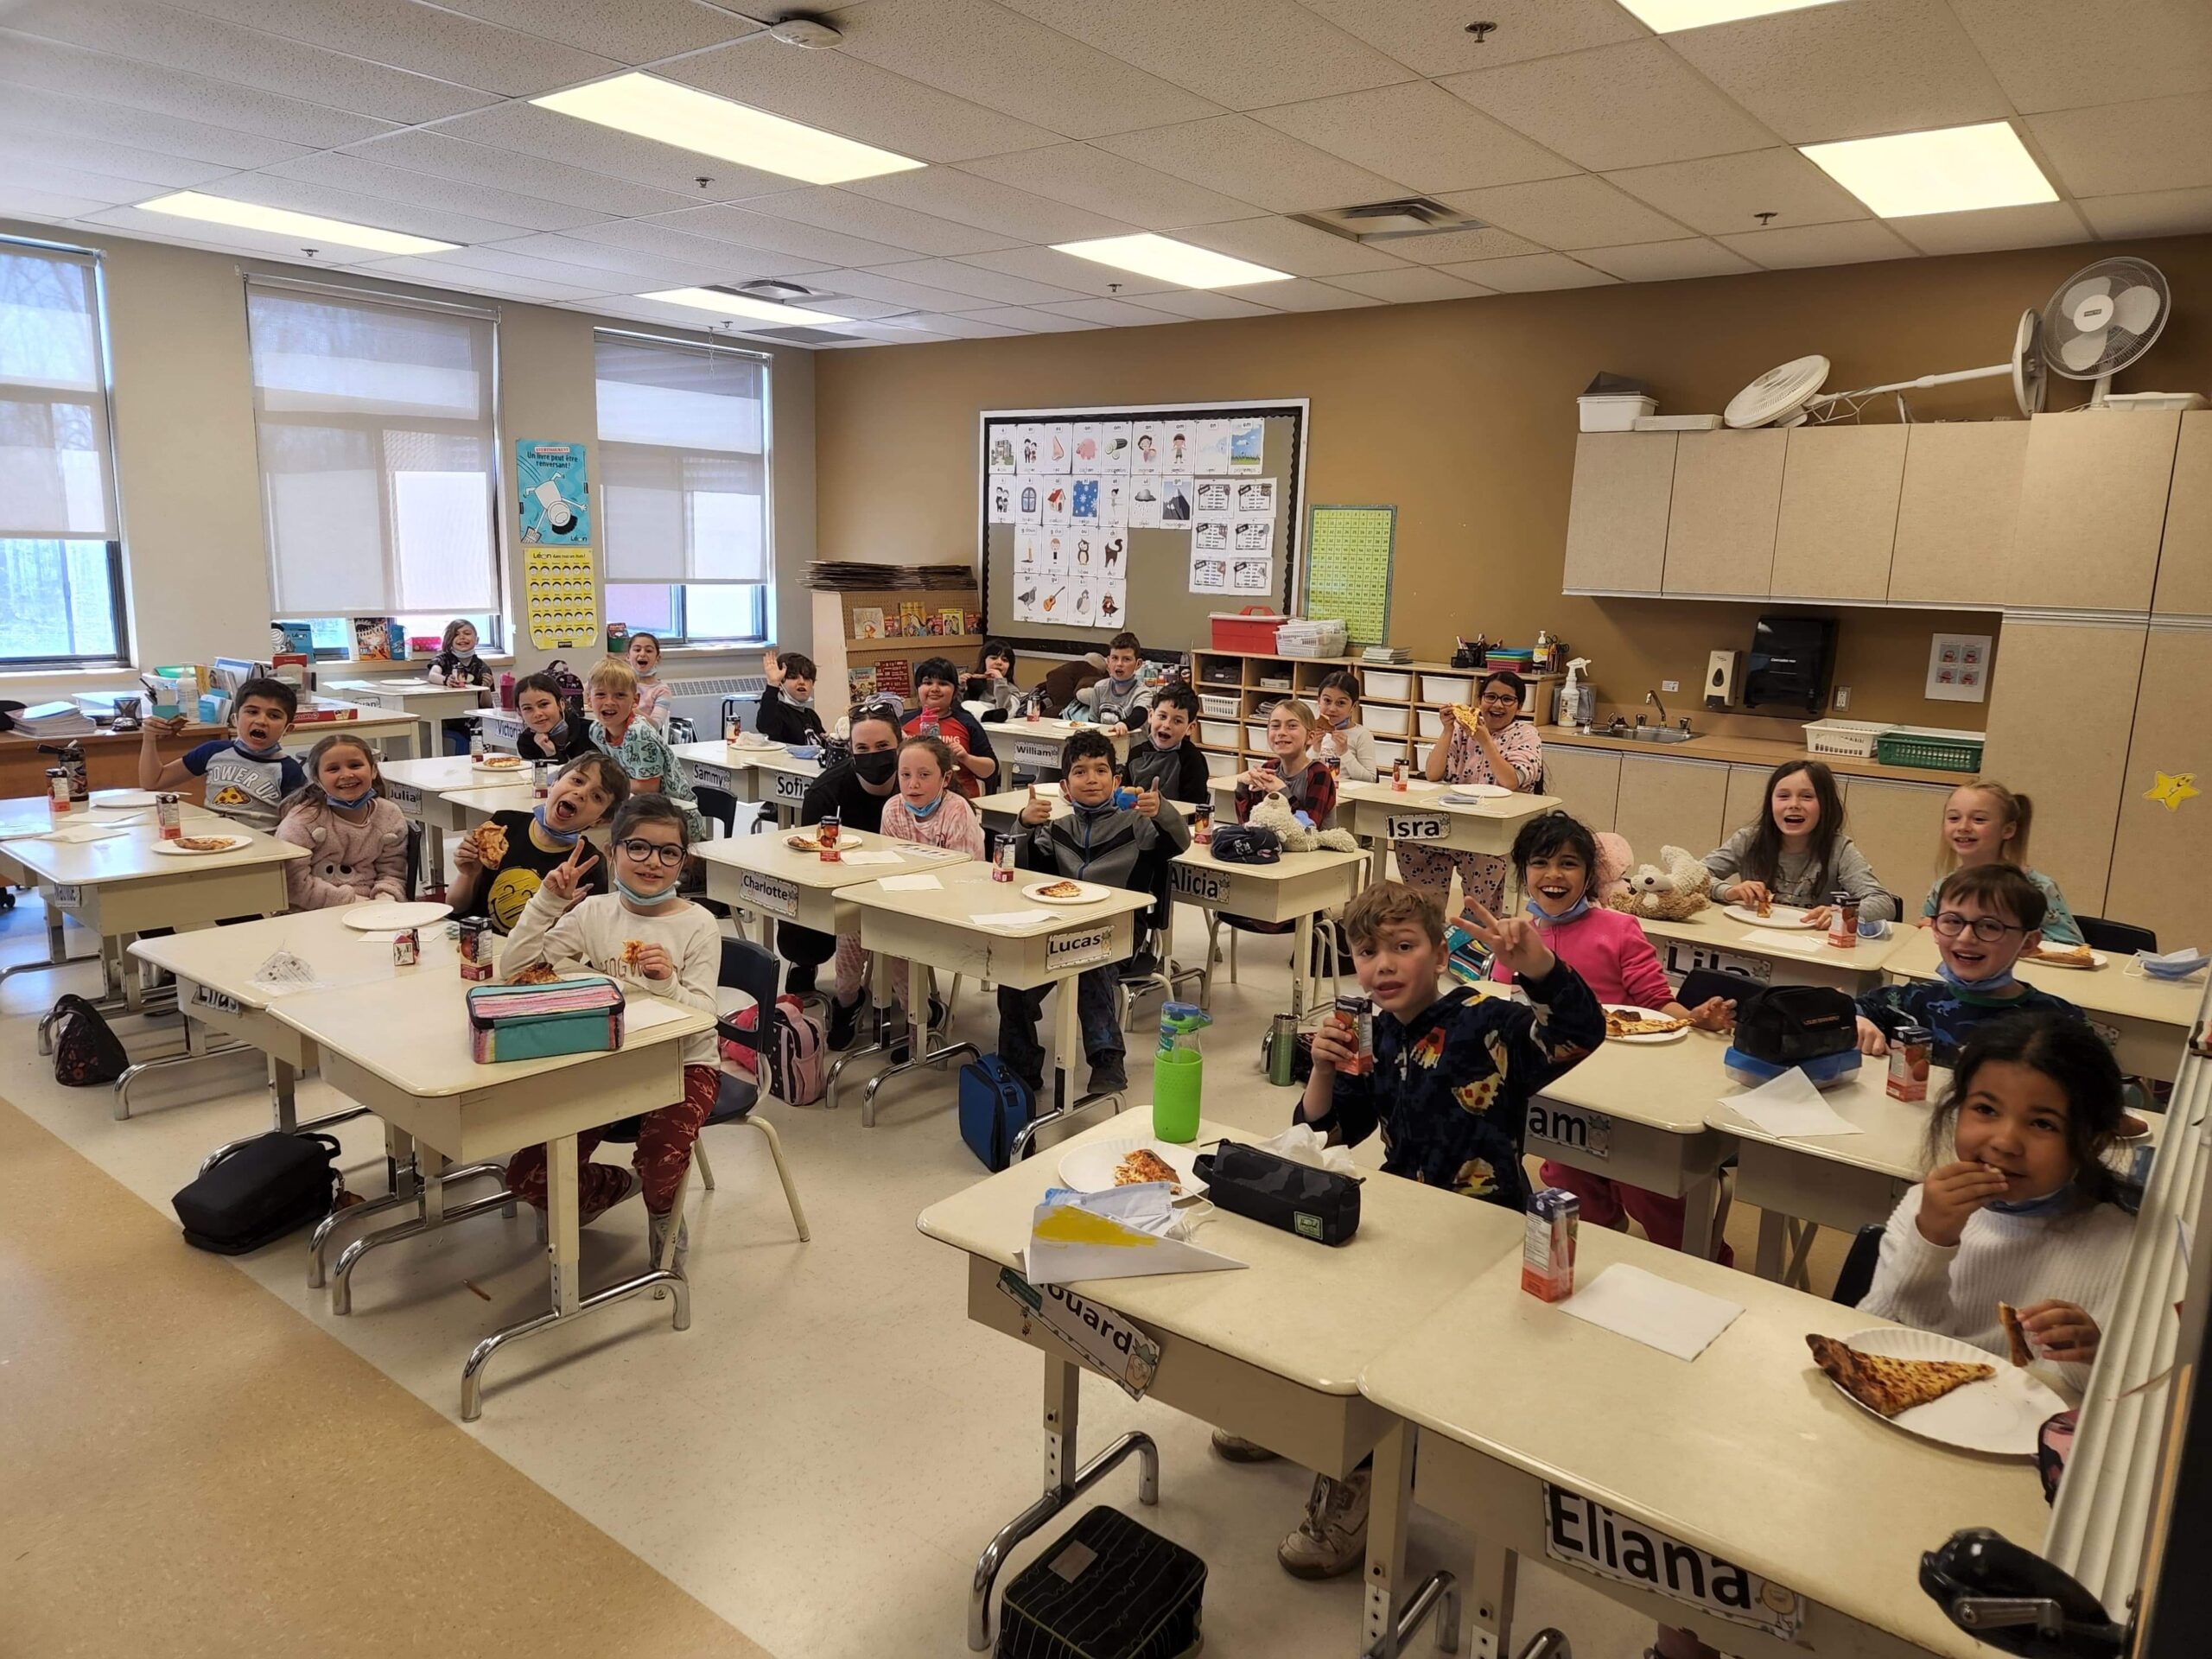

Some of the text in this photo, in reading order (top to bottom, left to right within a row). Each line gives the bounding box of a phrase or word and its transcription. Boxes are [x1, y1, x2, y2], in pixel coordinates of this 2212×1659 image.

[1017, 746, 1052, 757] William
[694, 764, 723, 787] Sammy
[255, 781, 279, 800] UP
[391, 790, 416, 803] Julia
[1388, 818, 1440, 837] Isra
[743, 874, 788, 900] Charlotte
[1049, 934, 1101, 954] Lucas
[1039, 1283, 1132, 1355] ouard
[1549, 1484, 1751, 1610] Eliana
